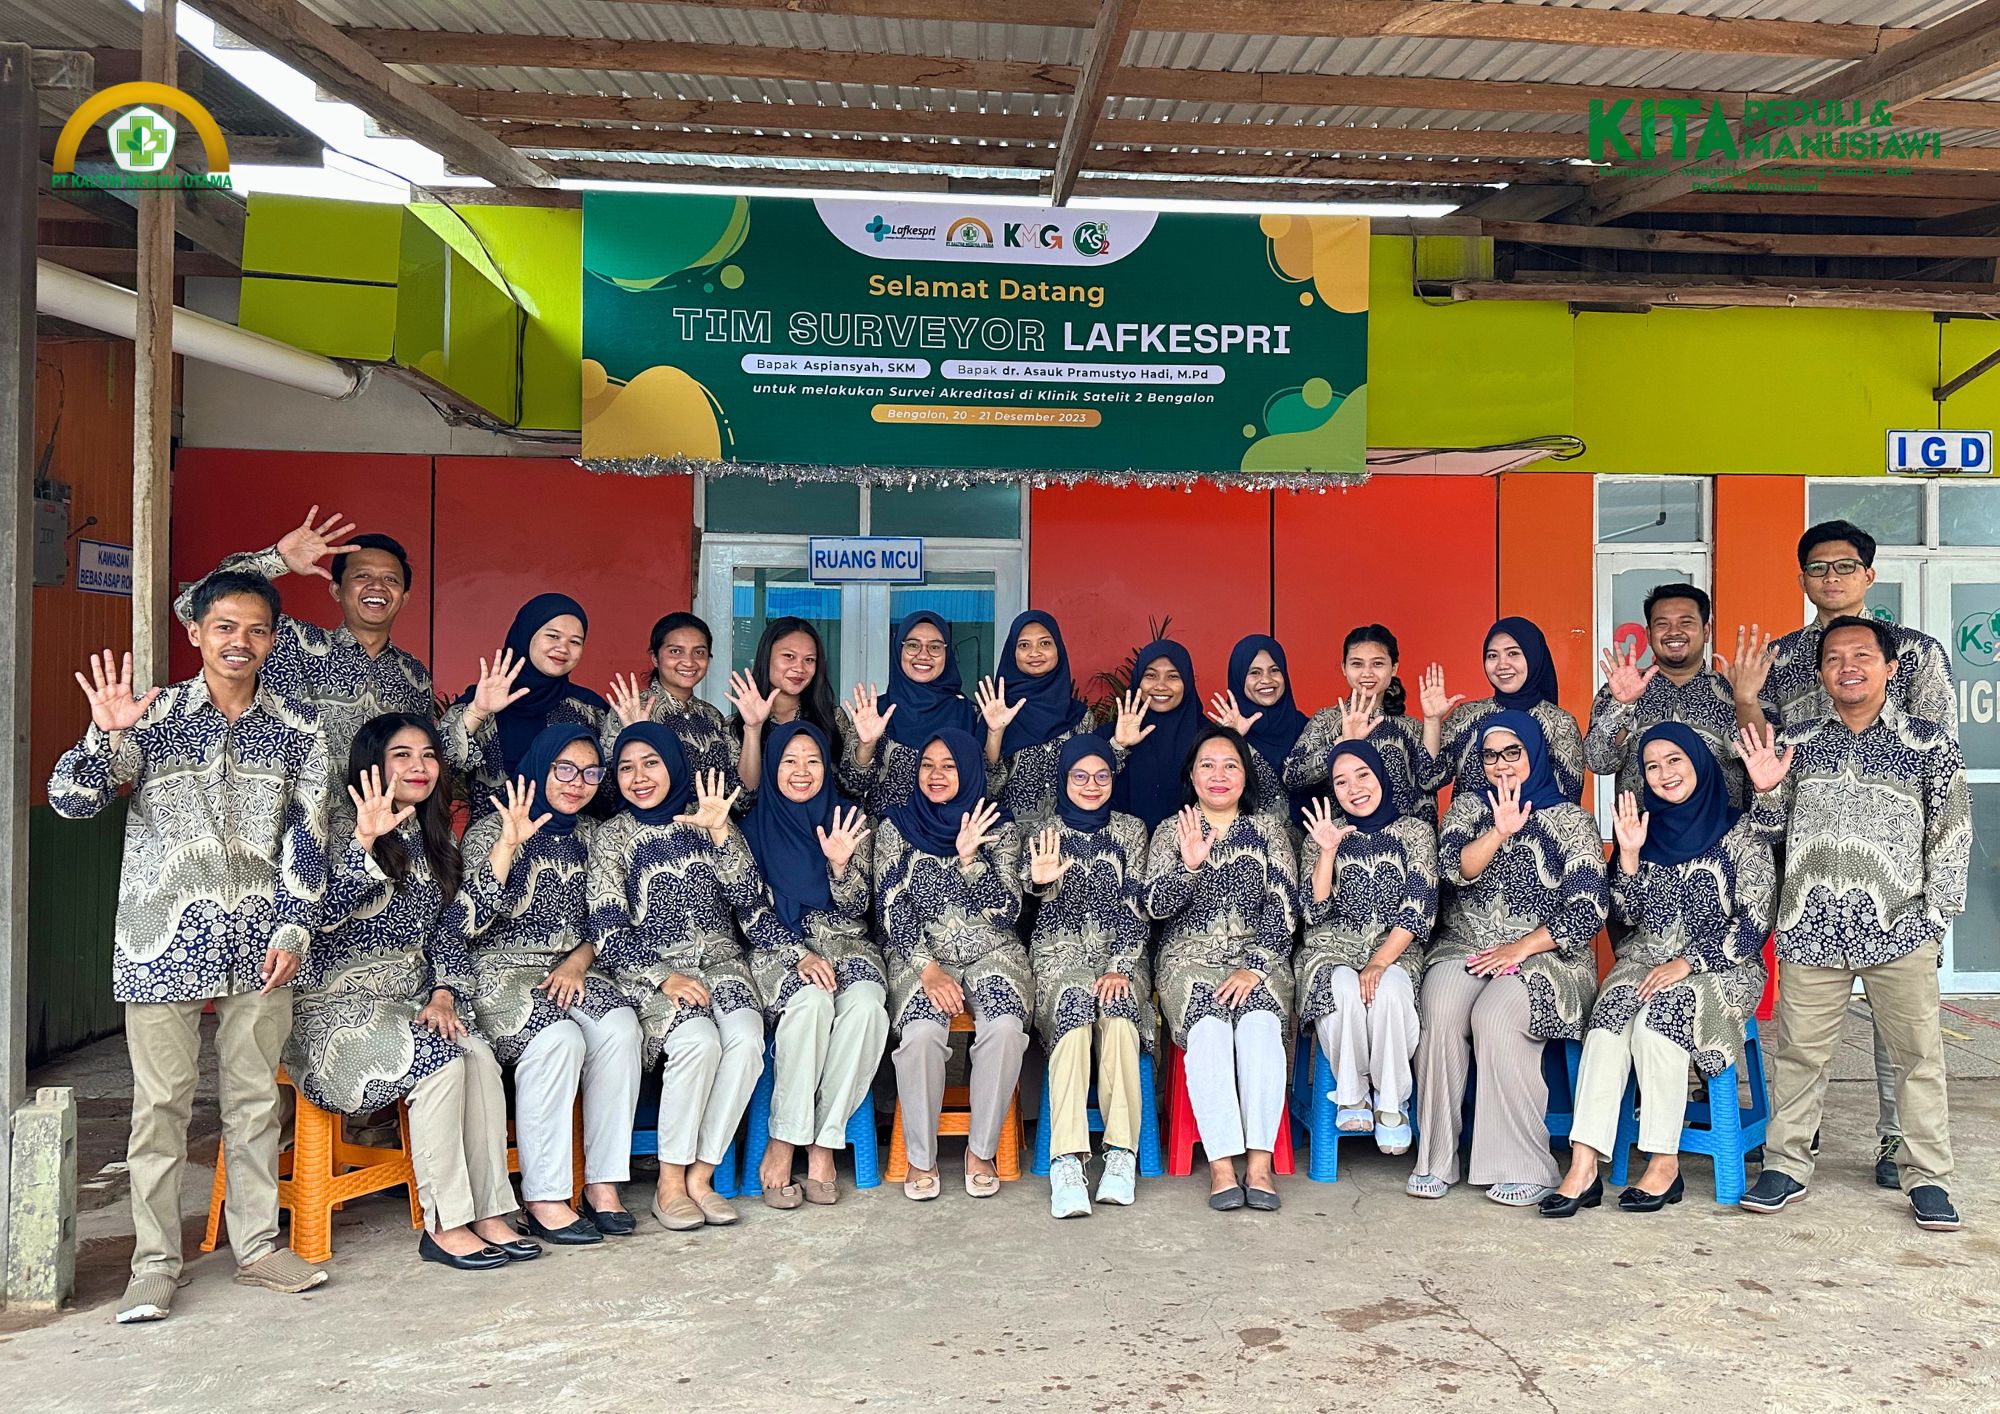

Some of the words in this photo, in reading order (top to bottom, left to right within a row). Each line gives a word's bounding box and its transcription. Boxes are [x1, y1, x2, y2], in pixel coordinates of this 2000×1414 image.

[891, 225, 937, 240] Lafkespri
[1003, 223, 1063, 249] KMG
[869, 274, 989, 298] Selamat
[1000, 279, 1105, 307] Datang
[672, 307, 772, 343] TIM
[788, 312, 1045, 352] SURVEYOR
[1064, 322, 1291, 354] LAFKESPRI
[757, 359, 798, 373] Bapak
[804, 361, 884, 375] Aspiansyah,
[888, 363, 916, 374] SKM
[958, 364, 997, 378] Bapak
[1002, 365, 1020, 376] dr.
[1024, 366, 1063, 377] Asauk
[1068, 367, 1137, 380] Pramustyo
[1141, 368, 1173, 381] Hadi,
[1178, 369, 1209, 380] M.Pd
[753, 383, 797, 394] untuk
[801, 384, 884, 397] melakukan
[889, 386, 936, 398] Survei
[939, 387, 1015, 400] Akreditasi
[1019, 389, 1033, 400] di
[1037, 390, 1079, 402] Klinik
[1083, 391, 1130, 403] Satelit
[1135, 392, 1143, 403] 2
[1147, 393, 1215, 405] Bengalon
[887, 409, 949, 422] Bengalon,
[953, 410, 968, 421] 20
[979, 412, 991, 421] 21
[995, 412, 1055, 424] Desember
[1059, 412, 1087, 423] 2023
[98, 550, 129, 568] KAWASAN
[814, 549, 876, 569] RUANG
[881, 550, 918, 569] MCU
[80, 569, 102, 585] BEBAS
[103, 573, 120, 588] ASAP
[1959, 679, 2000, 724] IG
